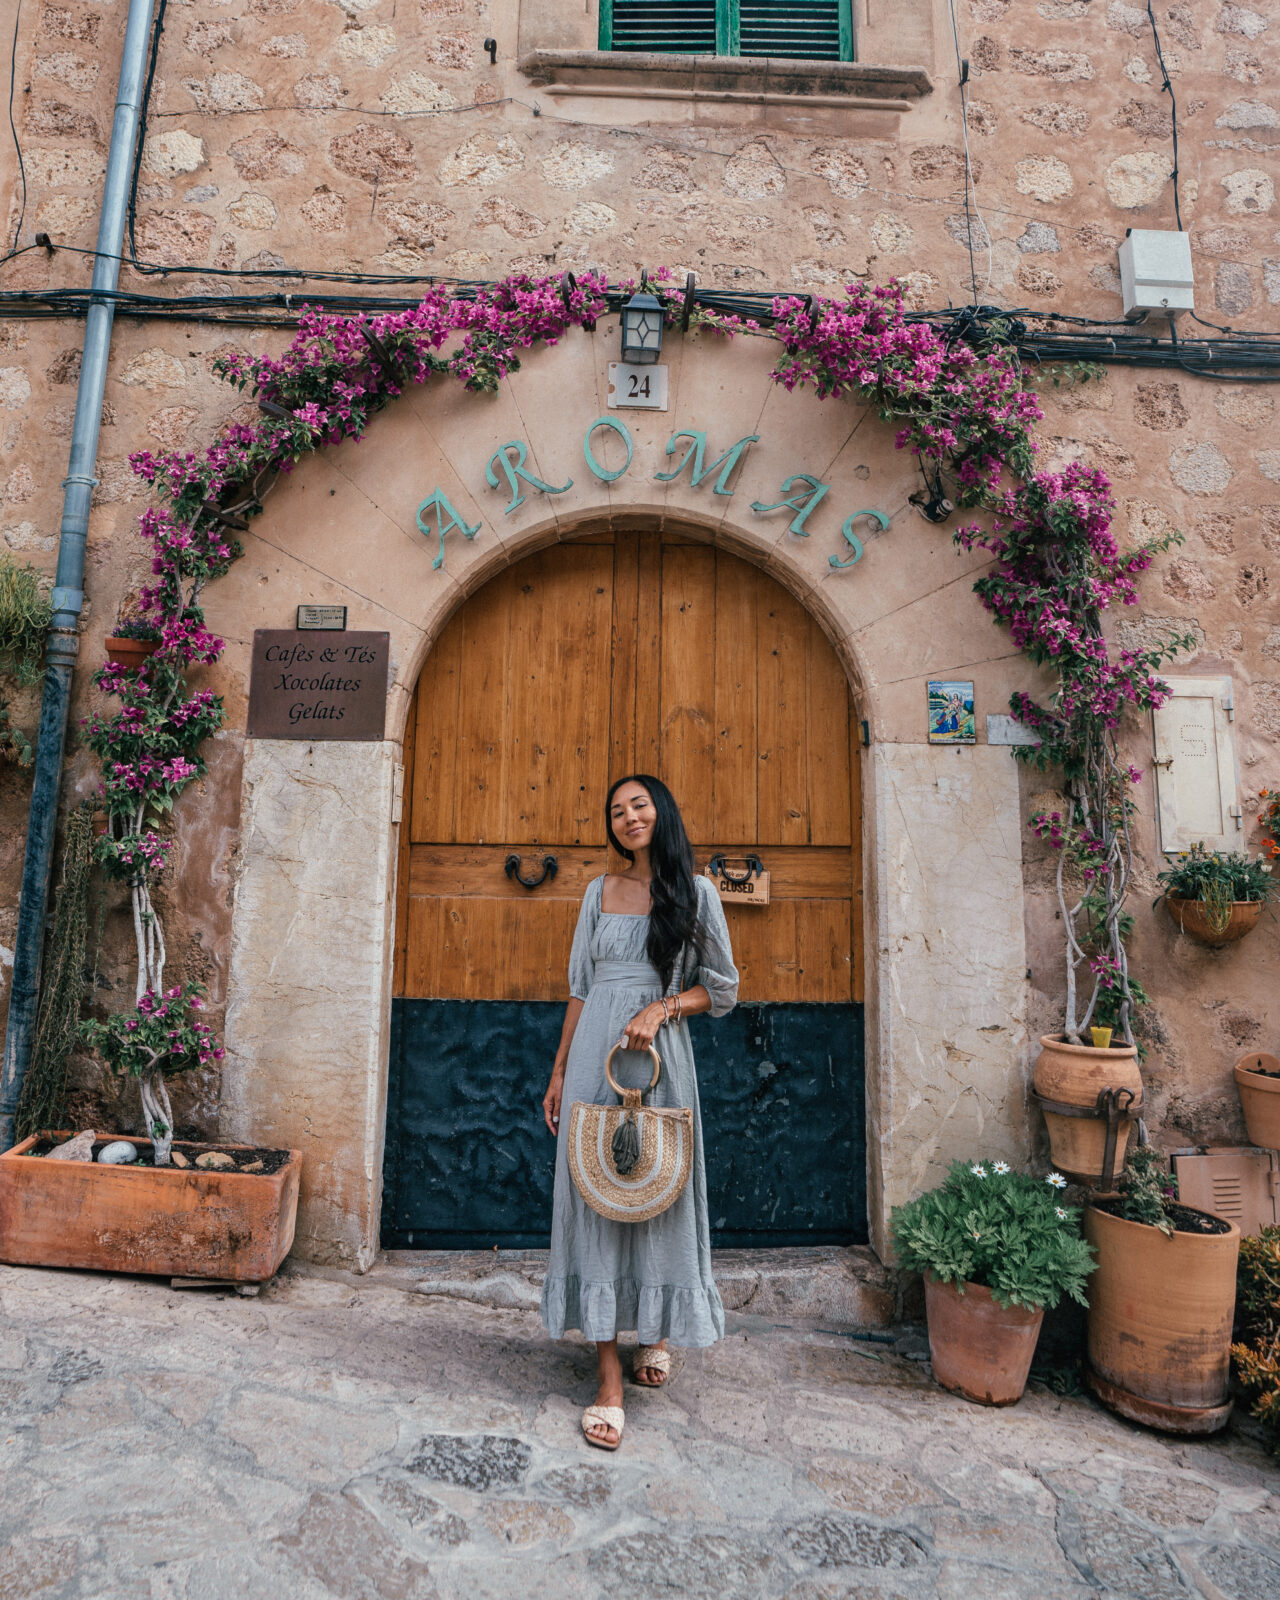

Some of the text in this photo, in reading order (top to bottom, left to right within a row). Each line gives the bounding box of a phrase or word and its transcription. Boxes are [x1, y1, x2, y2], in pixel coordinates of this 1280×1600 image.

[627, 374, 651, 399] 24
[416, 415, 891, 571] AROMAS
[319, 647, 339, 663] &
[345, 646, 376, 663] Tés
[273, 672, 361, 692] Xocolates
[288, 700, 346, 725] Gelats
[720, 880, 754, 894] CLOSED
